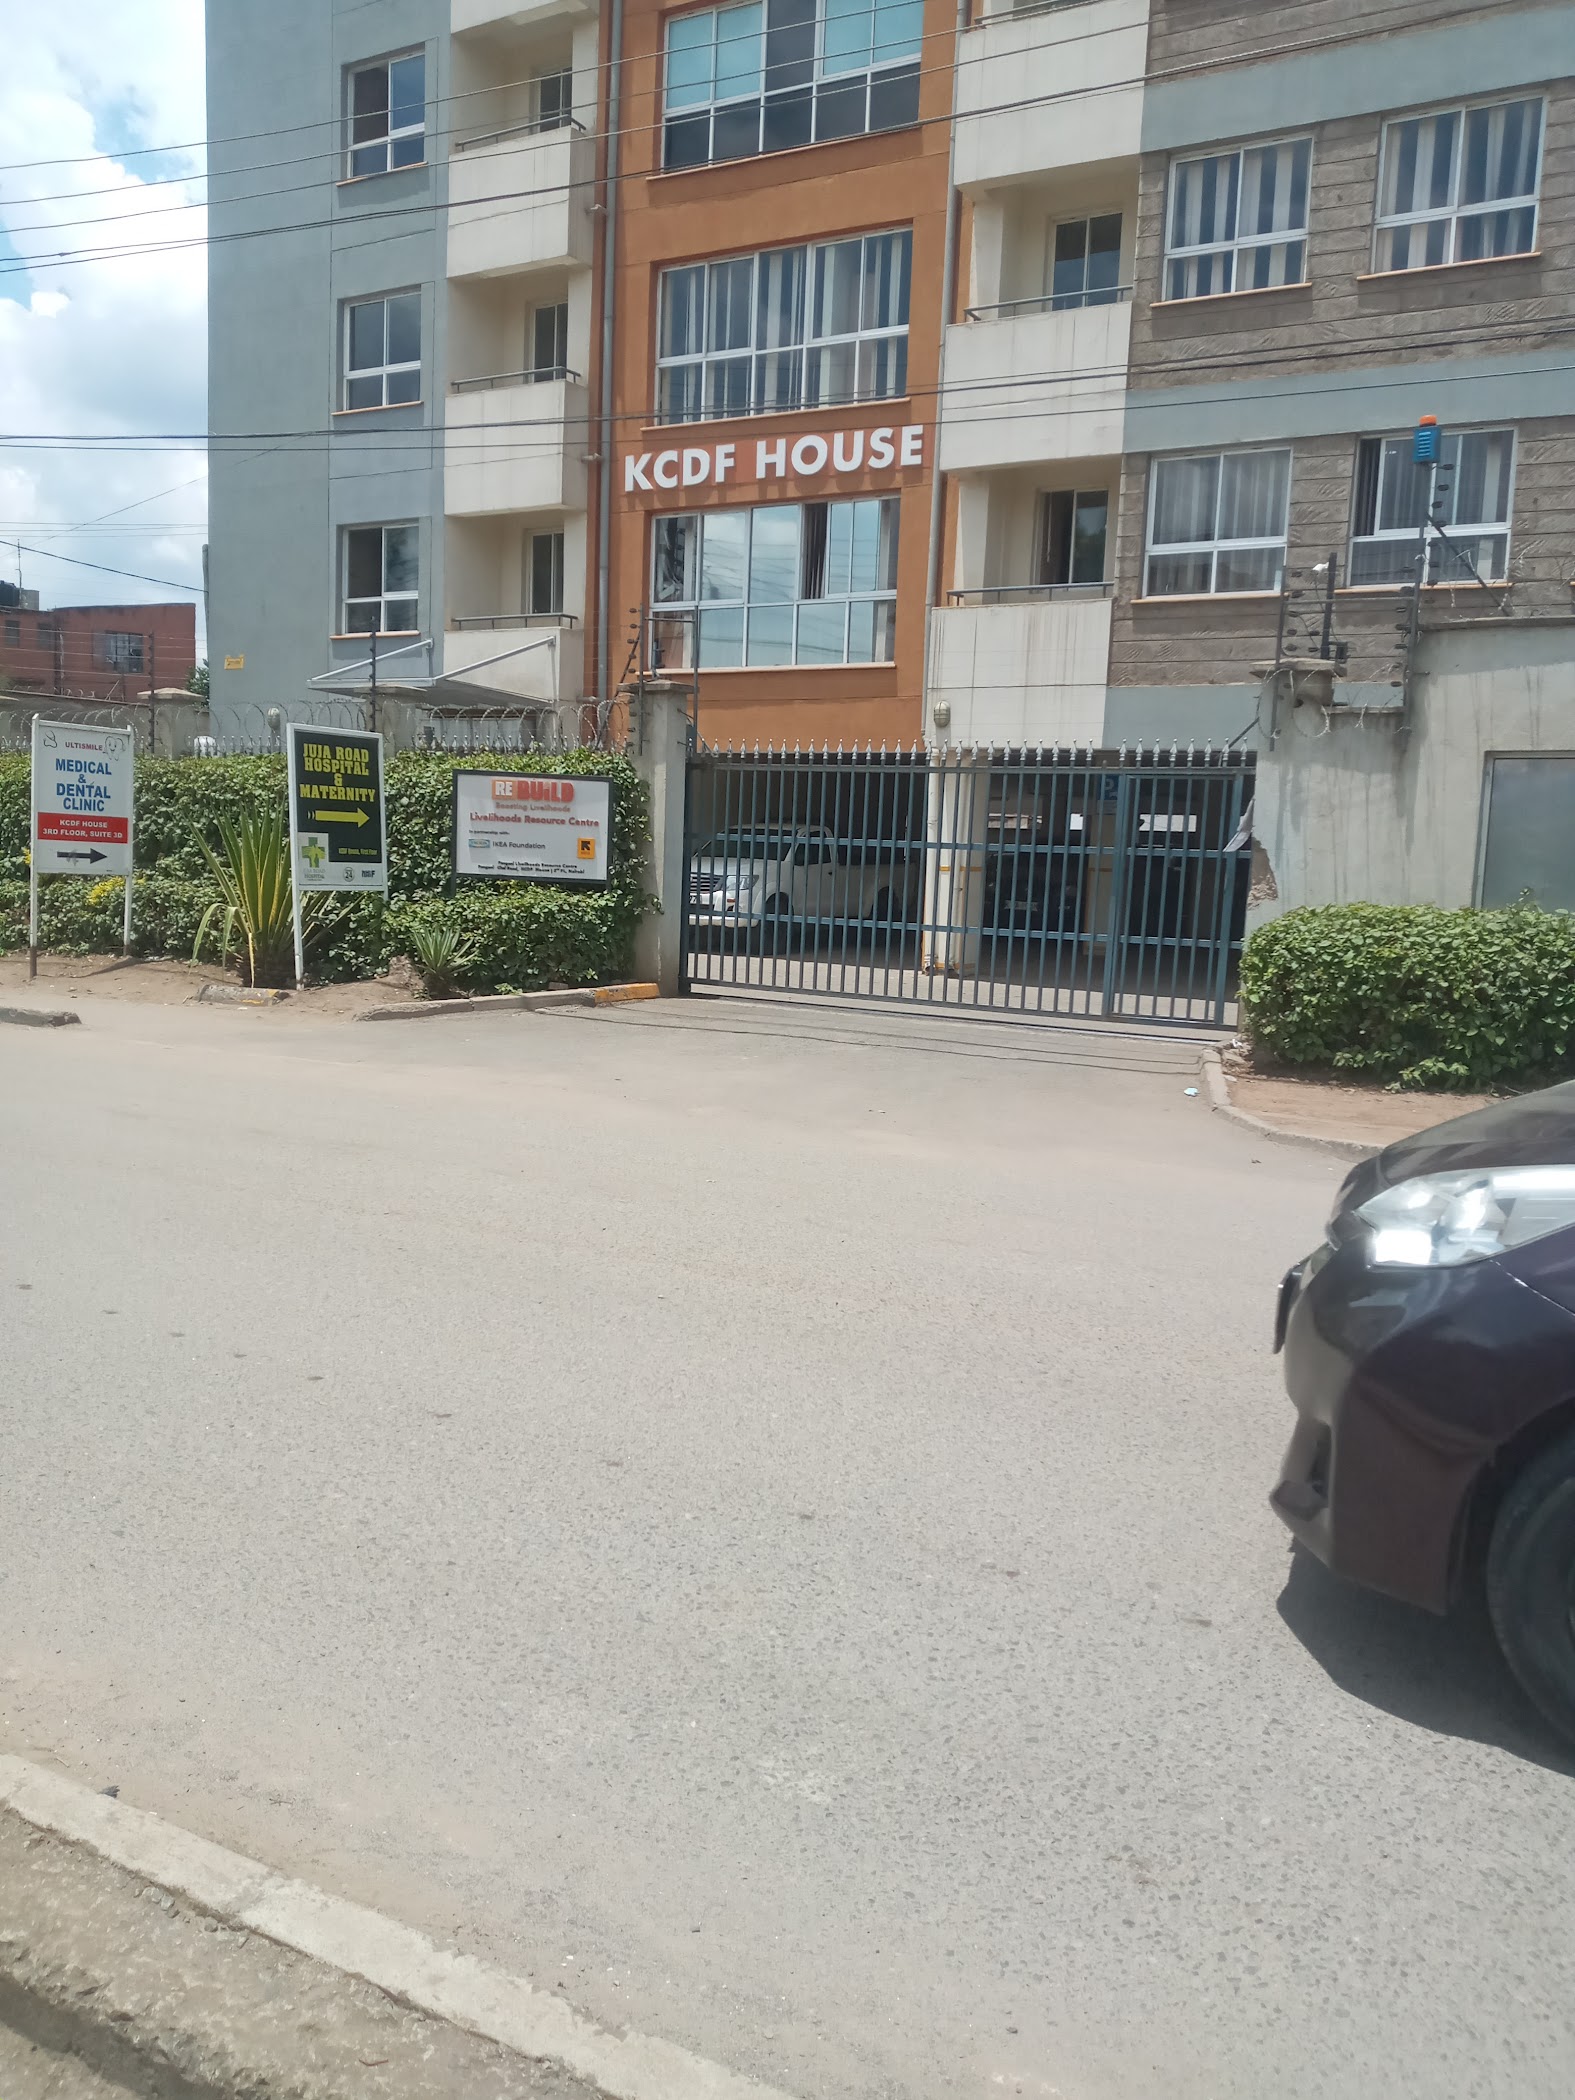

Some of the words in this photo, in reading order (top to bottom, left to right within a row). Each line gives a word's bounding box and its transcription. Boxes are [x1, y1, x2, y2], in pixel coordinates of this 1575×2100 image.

[624, 442, 736, 493] KCDF
[755, 424, 924, 479] HOUSE
[65, 741, 103, 752] ULTISMILE
[303, 743, 332, 760] JUJA
[335, 746, 369, 763] ROAD
[55, 758, 112, 775] MEDICAL
[304, 757, 369, 776] HOSPITAL
[78, 774, 86, 784] &
[333, 772, 343, 787] &
[56, 783, 111, 799] DENTAL
[299, 783, 376, 802] MATERNITY
[63, 797, 105, 812] CLINIC
[530, 804, 571, 813] Livelihoods
[59, 819, 81, 827] KCDF
[82, 820, 108, 828] HOUSE
[470, 812, 522, 824] Livelihoods
[525, 815, 566, 825] Resource
[568, 817, 600, 827] Centre
[60, 829, 88, 838] FLOOR,
[113, 831, 123, 839] 3D
[492, 840, 508, 848] IKEA
[509, 841, 546, 850] Foundation
[345, 871, 353, 879] 24
